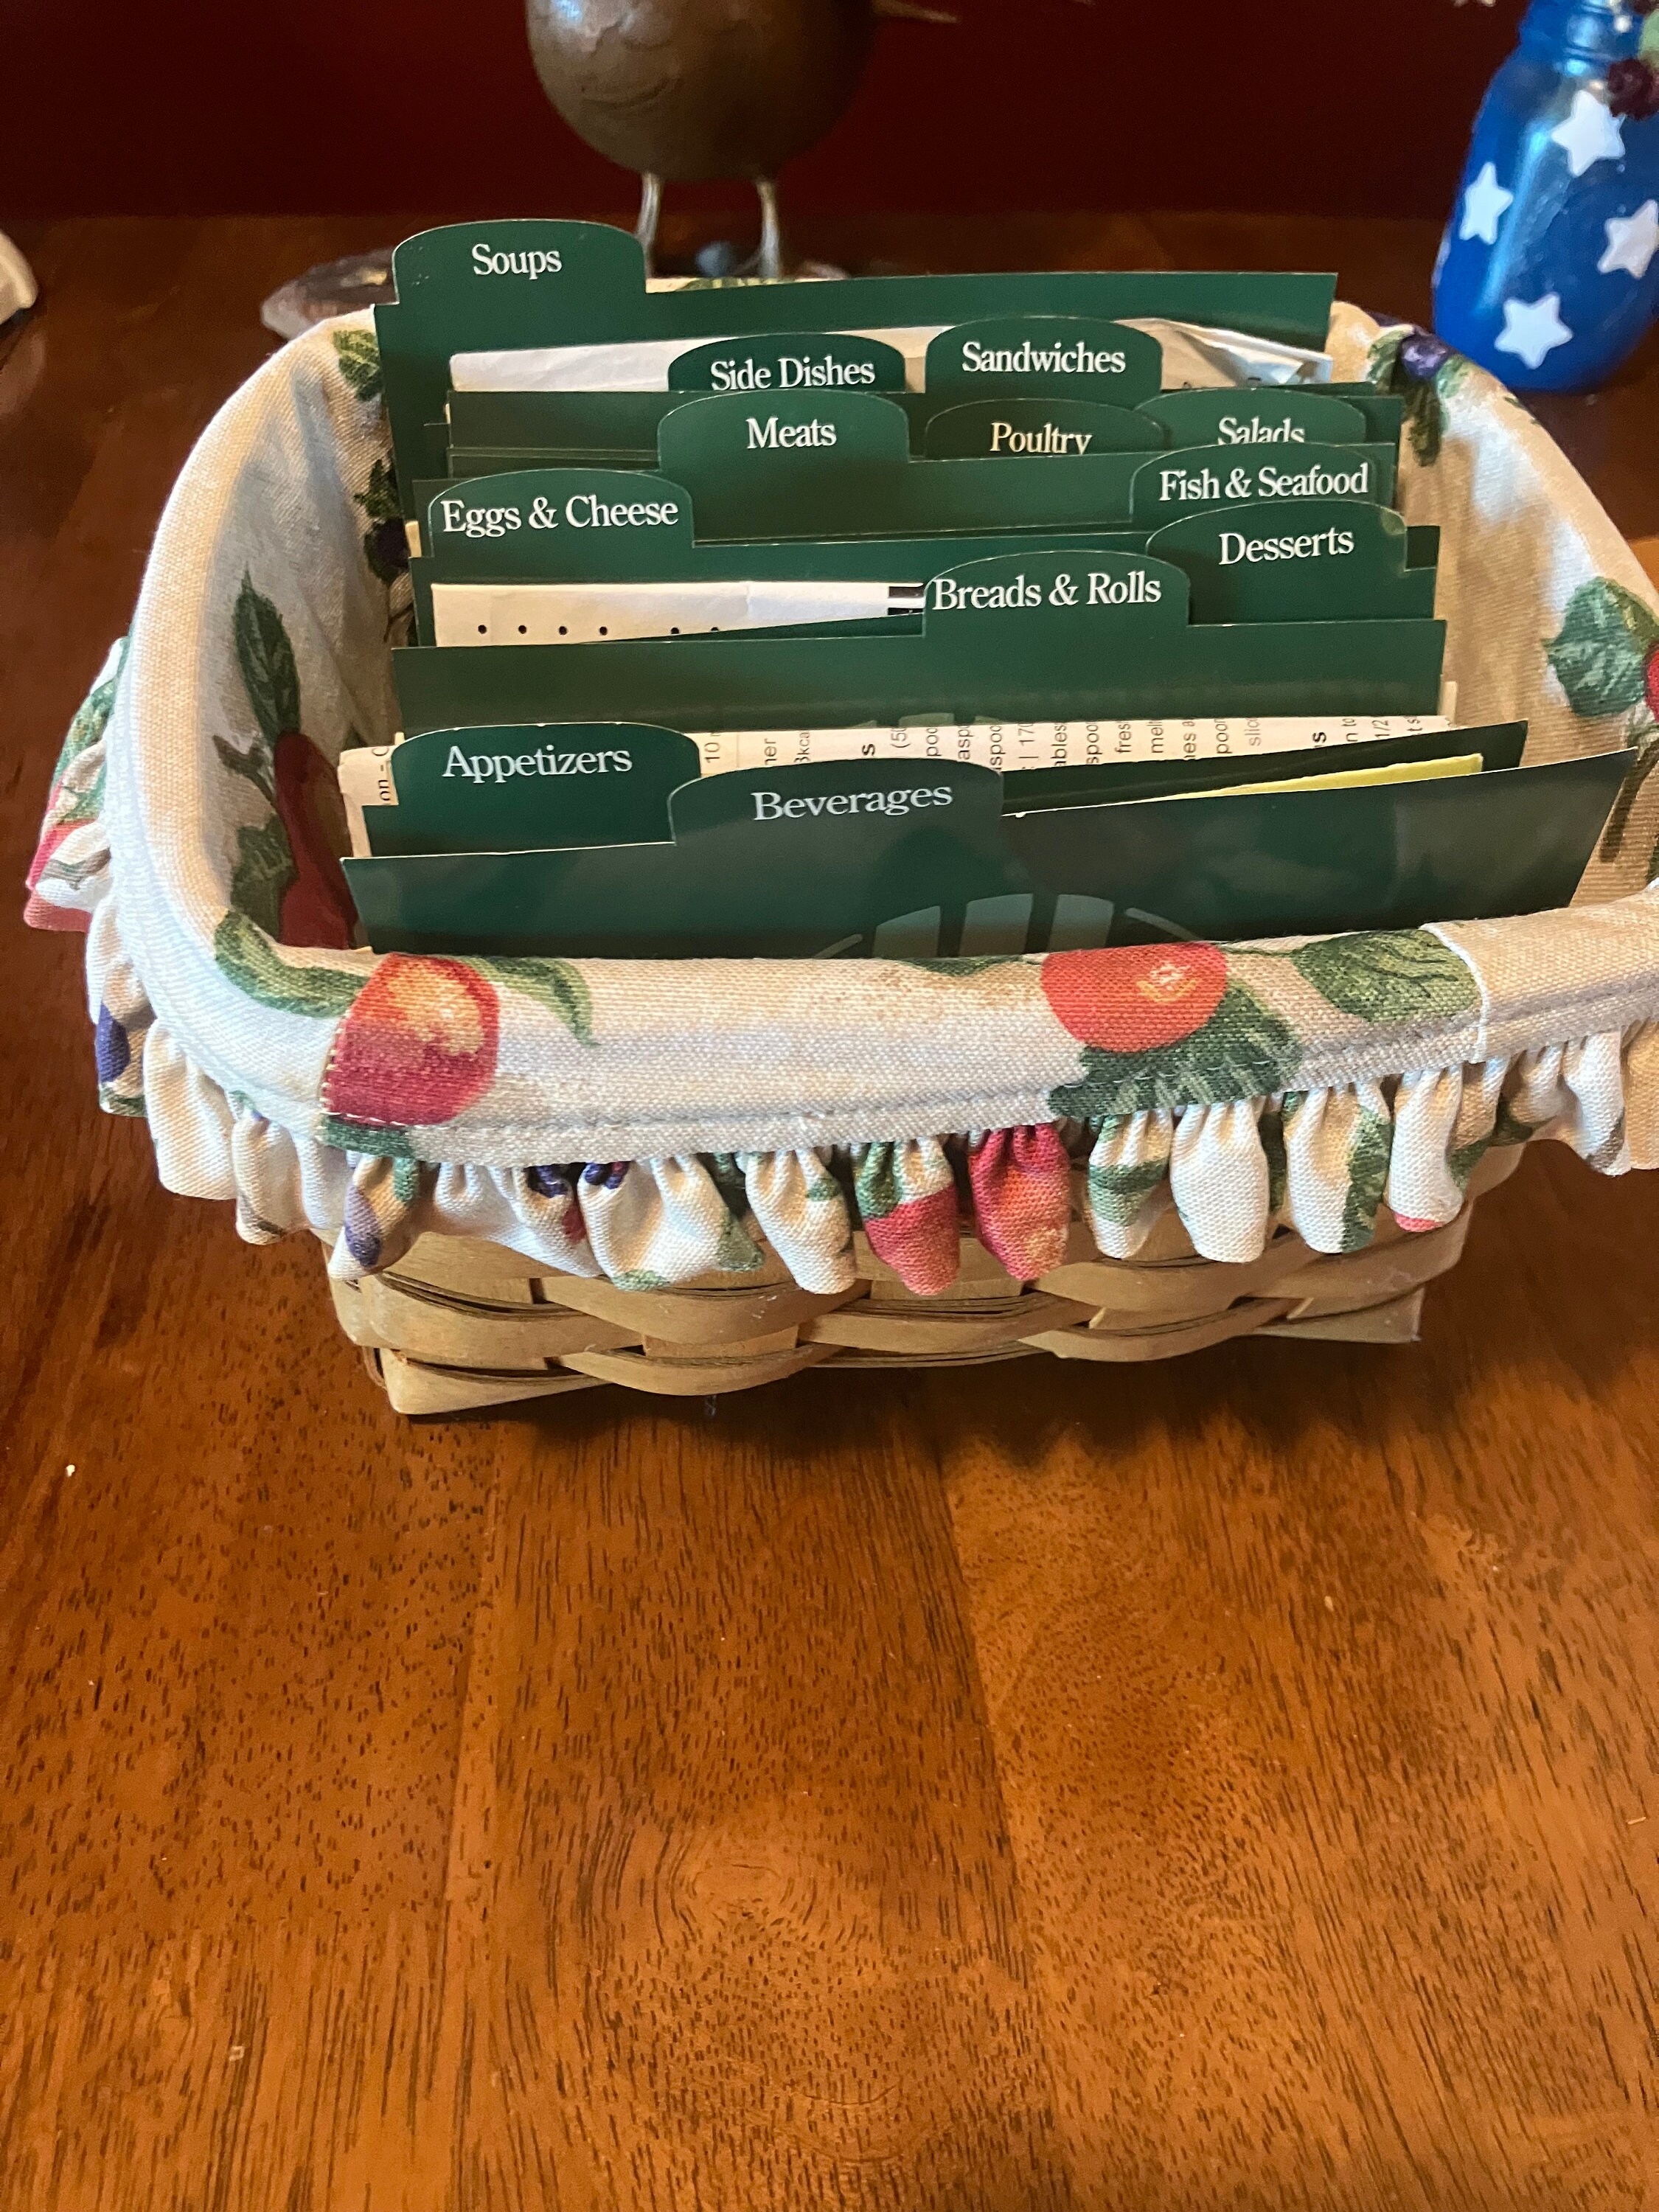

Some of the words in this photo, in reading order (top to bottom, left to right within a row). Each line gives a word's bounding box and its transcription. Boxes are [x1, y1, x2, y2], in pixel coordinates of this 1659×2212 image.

[472, 243, 563, 280] Soups
[710, 358, 771, 391] Side
[778, 355, 876, 389] Dishes
[961, 341, 1126, 373] Sandwiches
[745, 416, 837, 449] Meats
[990, 422, 1093, 455] Poultry
[1217, 416, 1305, 445] Salads
[1158, 468, 1220, 501] Fish
[1225, 468, 1252, 498] &
[1258, 462, 1368, 497] Seafood
[442, 499, 521, 538] Eggs
[528, 496, 558, 529] &
[565, 494, 679, 528] Cheese
[1218, 526, 1354, 566] Desserts
[933, 574, 1041, 611] Breads
[1048, 573, 1079, 606] &
[1087, 570, 1162, 605] Rolls
[442, 745, 633, 784] Appetizers
[751, 785, 953, 821] Beverages
